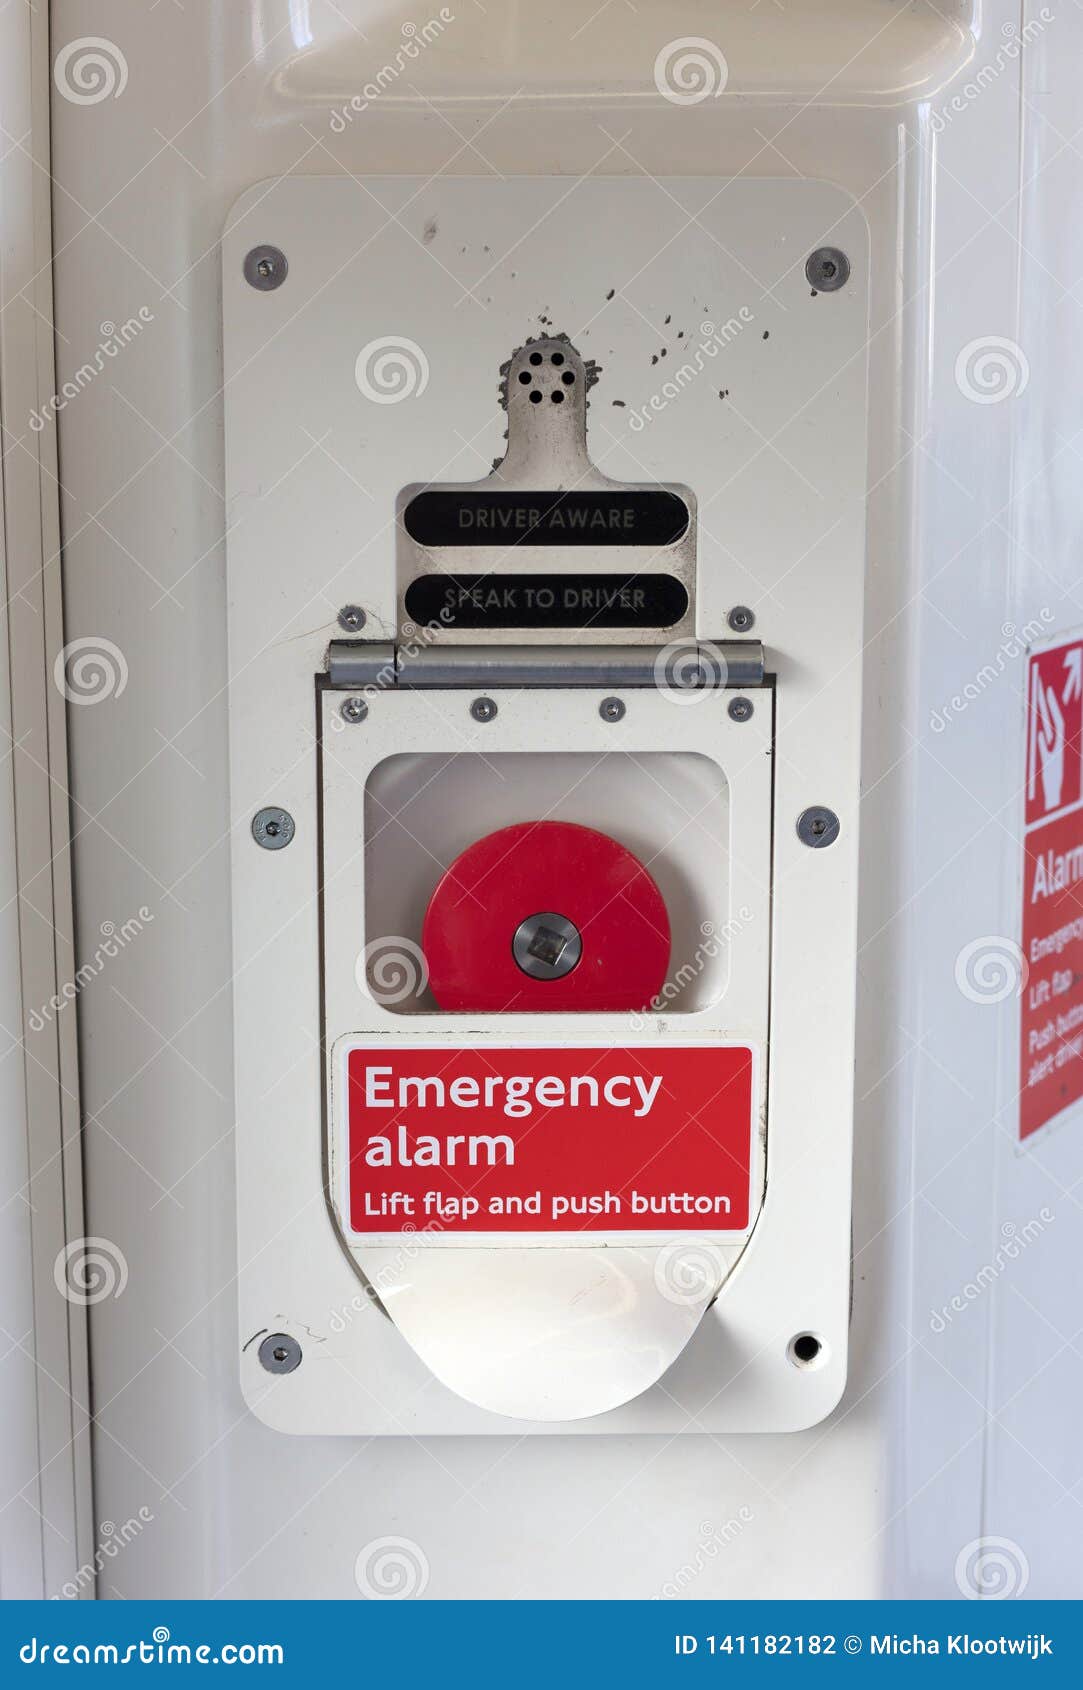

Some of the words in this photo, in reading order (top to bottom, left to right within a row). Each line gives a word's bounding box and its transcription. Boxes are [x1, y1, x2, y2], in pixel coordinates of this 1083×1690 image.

[459, 509, 540, 528] DRIVER
[550, 509, 635, 528] AWARE
[445, 589, 516, 608] SPEAK
[525, 589, 554, 608] TO
[564, 589, 646, 608] DRIVER
[365, 1066, 664, 1117] Emergency
[365, 1126, 515, 1167] alarm
[365, 1192, 415, 1216] Lift
[423, 1192, 480, 1220] flap
[489, 1192, 541, 1215] and
[552, 1192, 622, 1220] push
[632, 1192, 731, 1215] button
